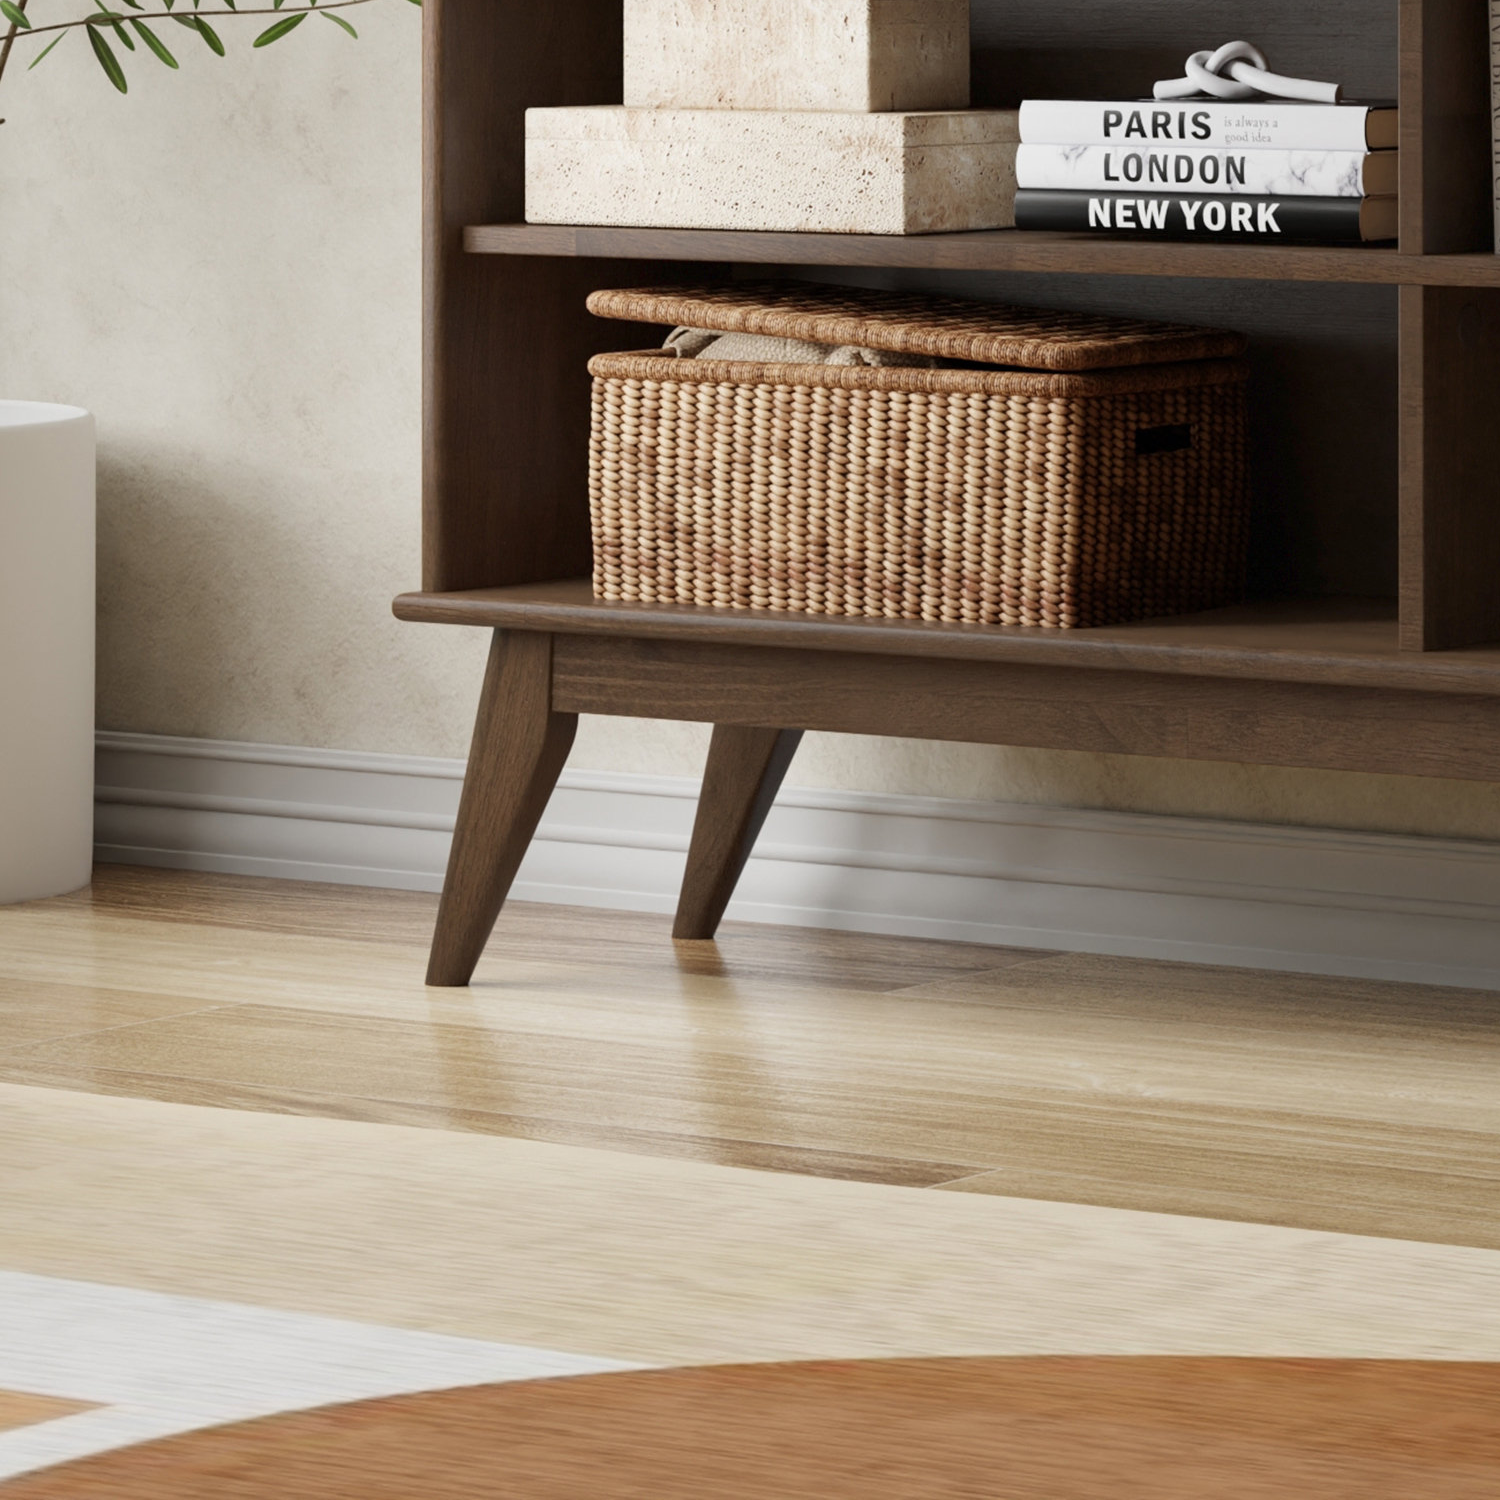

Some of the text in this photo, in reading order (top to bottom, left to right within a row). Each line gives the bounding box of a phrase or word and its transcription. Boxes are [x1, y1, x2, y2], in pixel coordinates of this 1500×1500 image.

[1103, 110, 1279, 140] PARIS is always a
[1224, 130, 1273, 144] good idea
[1103, 153, 1246, 185] LONDON
[1088, 198, 1282, 233] NEW YORK
